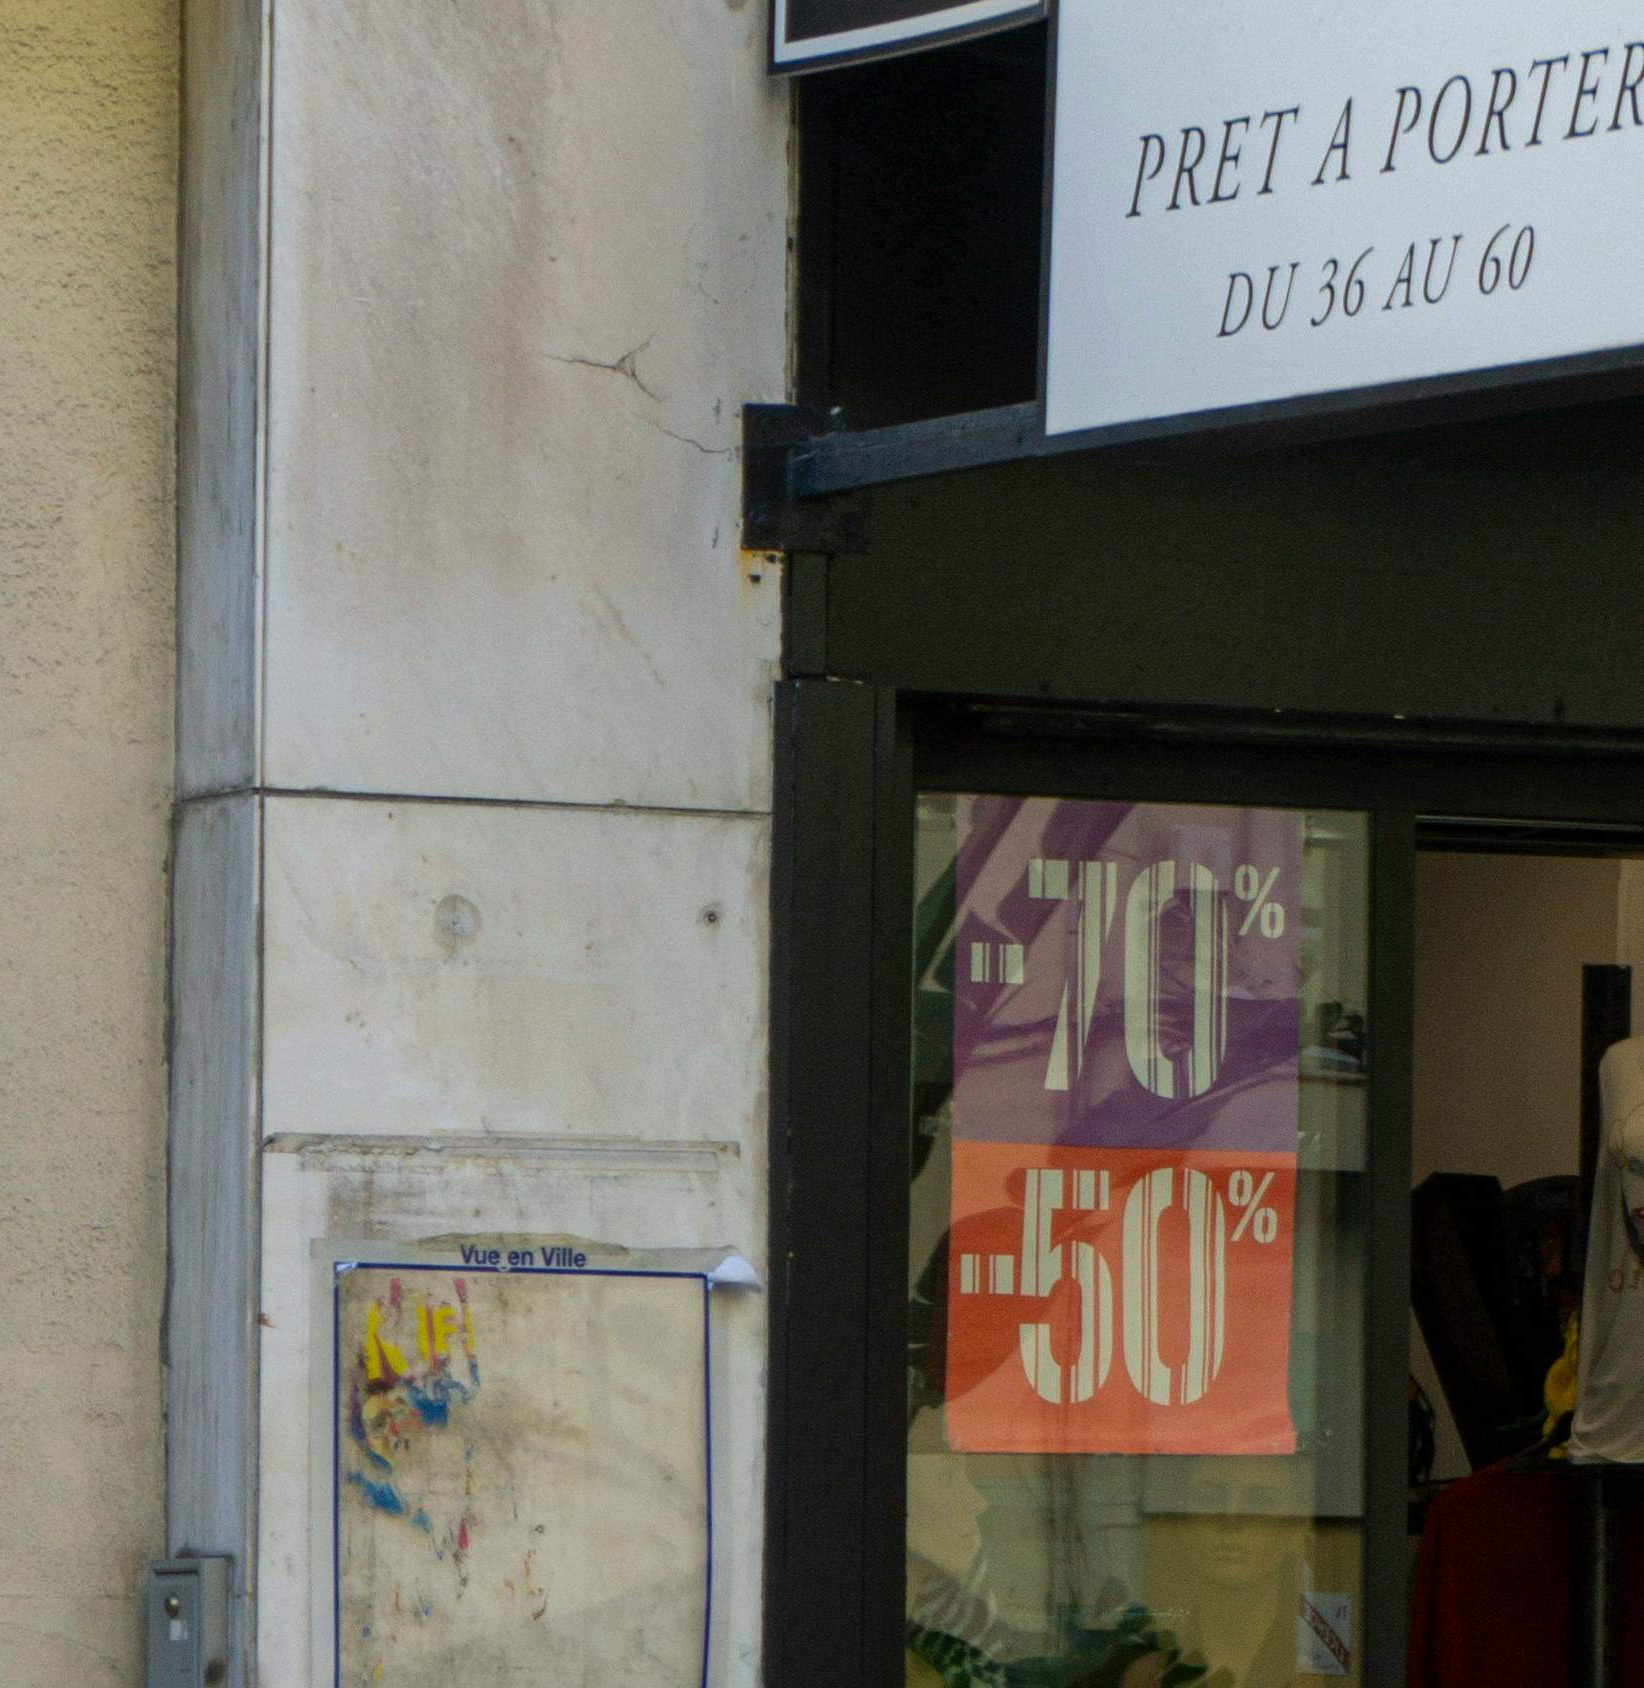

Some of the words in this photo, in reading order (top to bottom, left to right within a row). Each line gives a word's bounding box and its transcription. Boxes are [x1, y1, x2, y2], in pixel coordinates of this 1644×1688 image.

[1125, 106, 1300, 218] PRET
[1311, 97, 1353, 186] A
[1379, 41, 1644, 174] PORTER
[1217, 262, 1300, 338] DU
[1310, 247, 1374, 328] 36
[1382, 234, 1463, 311] AU
[1478, 224, 1535, 295] 60
[459, 1244, 501, 1264] Vue
[507, 1250, 534, 1266] en
[540, 1247, 588, 1268] Ville
[960, 1166, 1278, 1406] -50%
